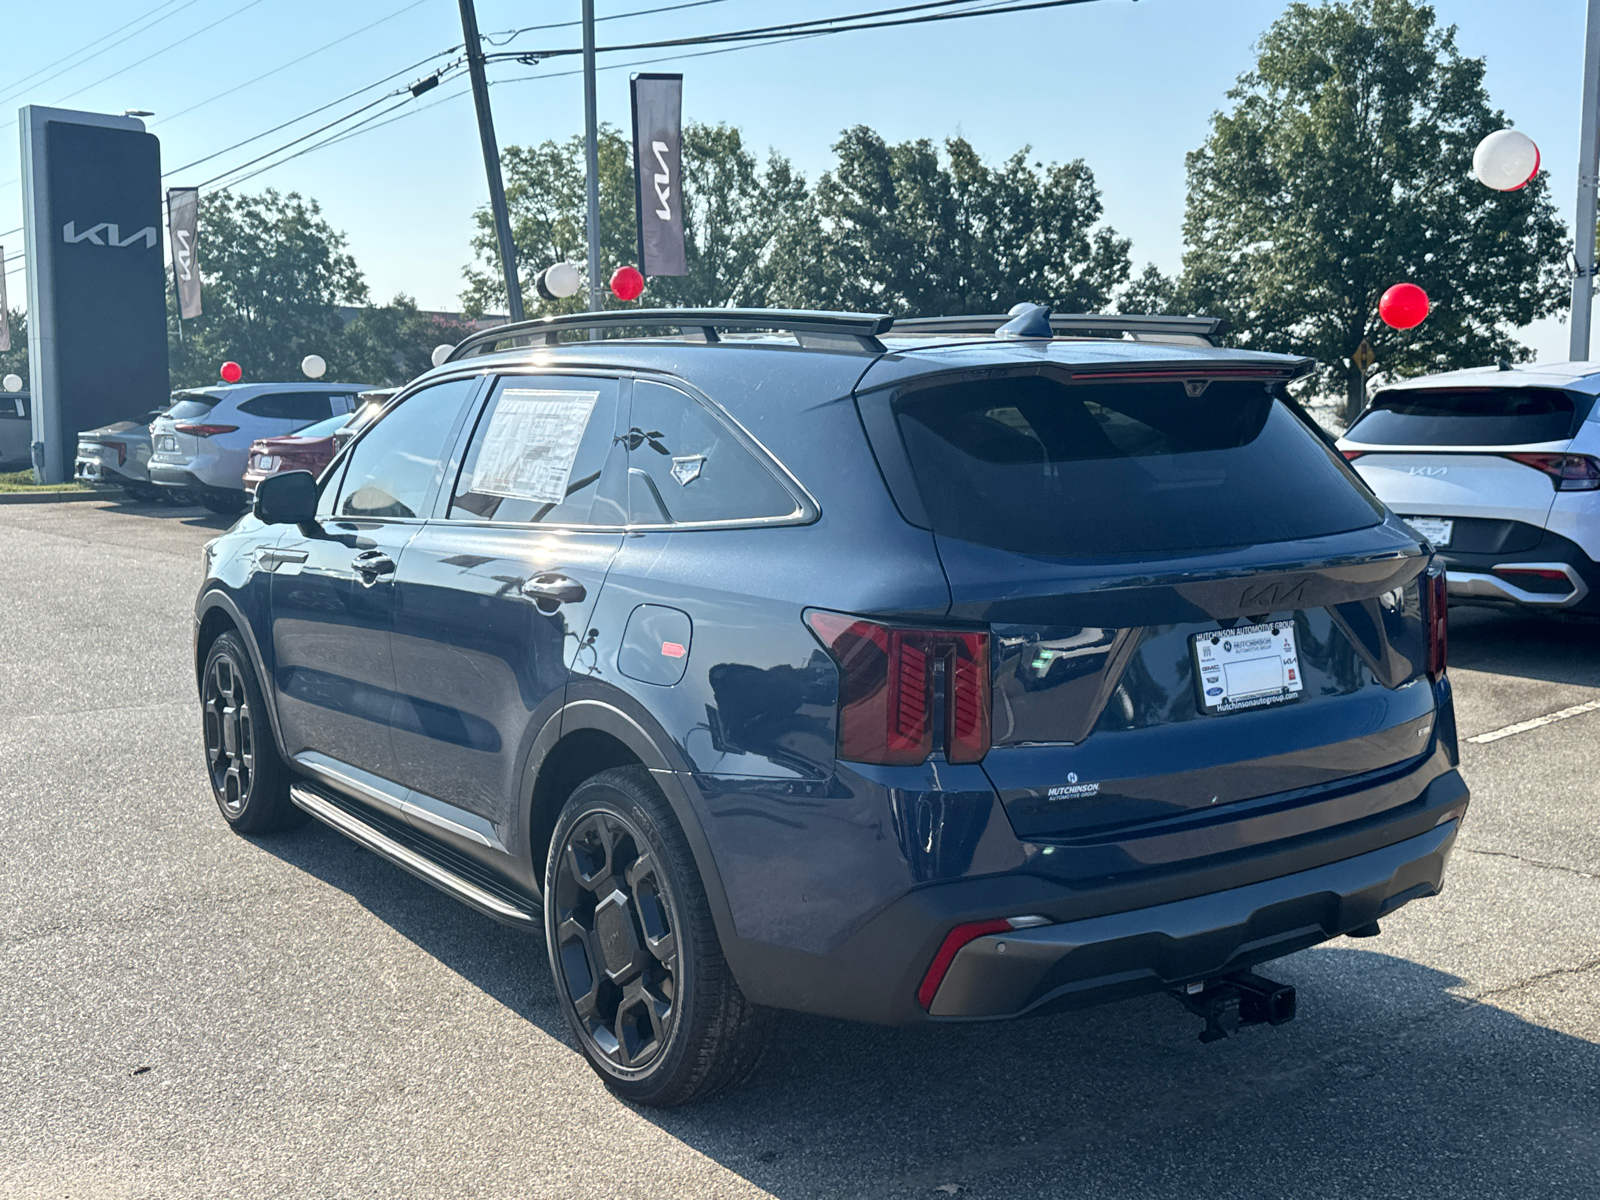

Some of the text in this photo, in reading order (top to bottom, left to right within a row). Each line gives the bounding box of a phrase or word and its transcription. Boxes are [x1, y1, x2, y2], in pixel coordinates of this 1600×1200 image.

[63, 220, 157, 249] KIA
[1236, 623, 1274, 636] AUTOMOTIVE
[1275, 620, 1295, 631] GROUP
[1216, 692, 1299, 712] Hutchinsonautogroup.com
[1048, 783, 1099, 797] HUTCHINSON
